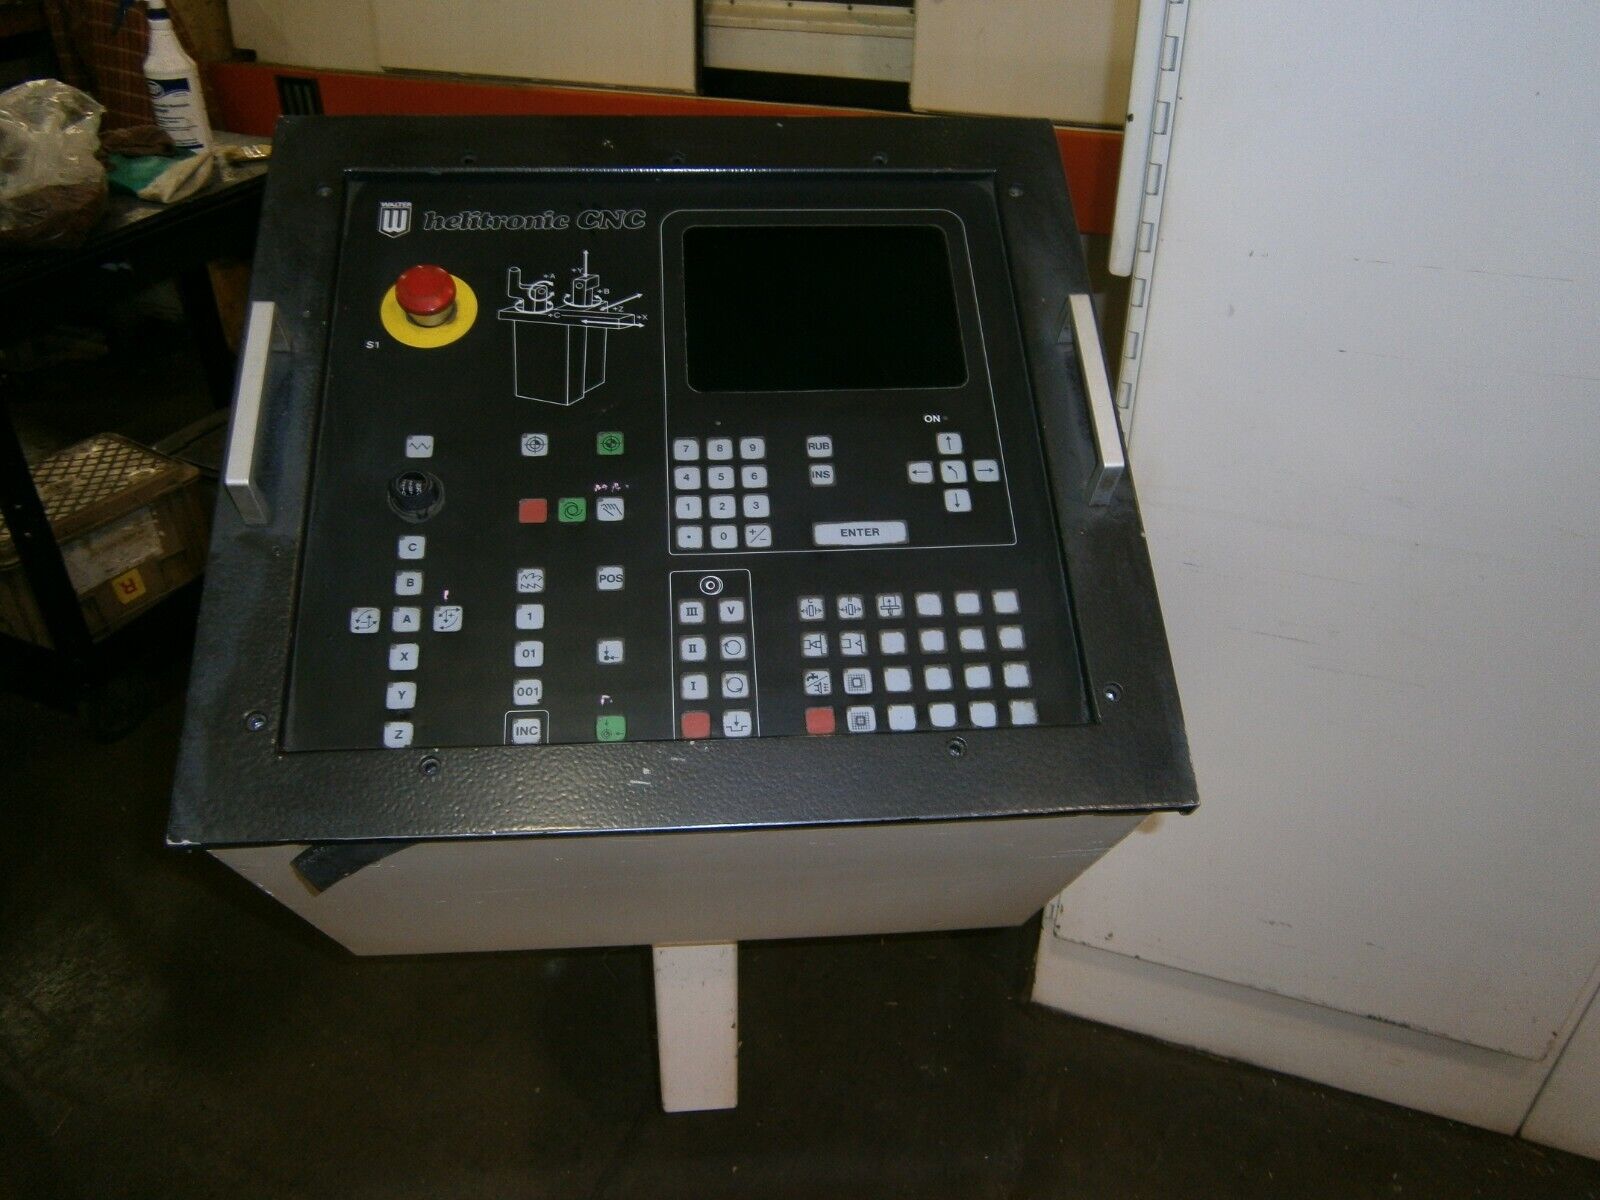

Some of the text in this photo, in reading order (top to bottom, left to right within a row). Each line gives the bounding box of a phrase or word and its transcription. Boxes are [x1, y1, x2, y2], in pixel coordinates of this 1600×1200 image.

[423, 209, 647, 230] helitronic CNC
[366, 340, 380, 349] S1
[924, 414, 941, 423] ON
[682, 444, 690, 453] 7
[716, 444, 724, 452] 8
[749, 443, 756, 452] 9
[808, 442, 830, 450] RUB
[683, 473, 690, 482] 4
[718, 473, 725, 481] 5
[751, 472, 758, 480] 6
[812, 470, 830, 479] INS
[719, 502, 726, 511] 2
[753, 502, 760, 510] 3
[720, 532, 728, 540] 0
[840, 528, 880, 537] ENTER
[408, 542, 418, 552] C
[406, 578, 414, 587] B
[600, 574, 624, 584] POS
[686, 607, 698, 616] III
[727, 606, 735, 615] V
[402, 614, 412, 624] A
[400, 652, 408, 662] X
[522, 649, 536, 658] 01
[398, 690, 406, 700] Y
[517, 687, 539, 697] 001
[395, 730, 404, 740] Z
[516, 726, 538, 736] INC
